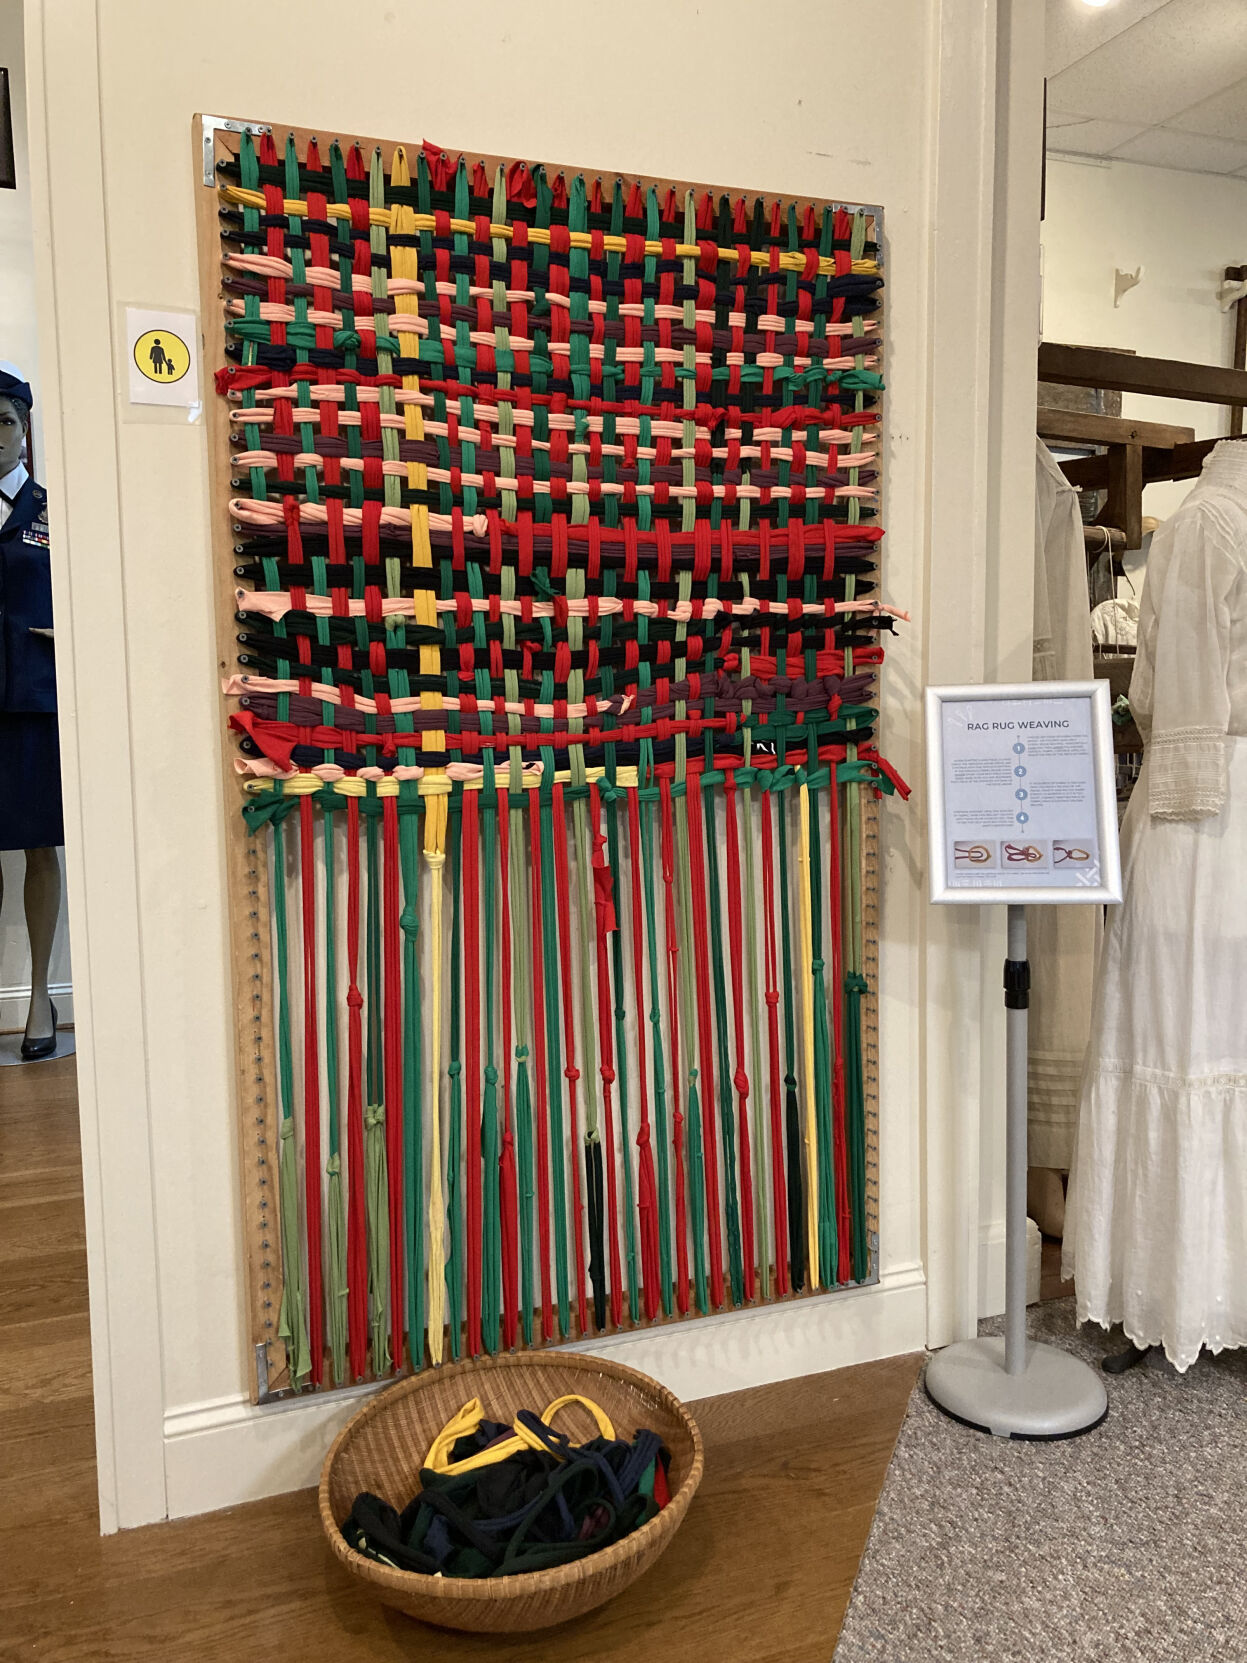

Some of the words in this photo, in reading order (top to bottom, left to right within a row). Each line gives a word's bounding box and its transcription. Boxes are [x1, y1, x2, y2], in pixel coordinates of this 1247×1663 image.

[967, 722, 989, 731] RAG
[992, 721, 1015, 730] RUG
[1017, 720, 1070, 729] WEAVING
